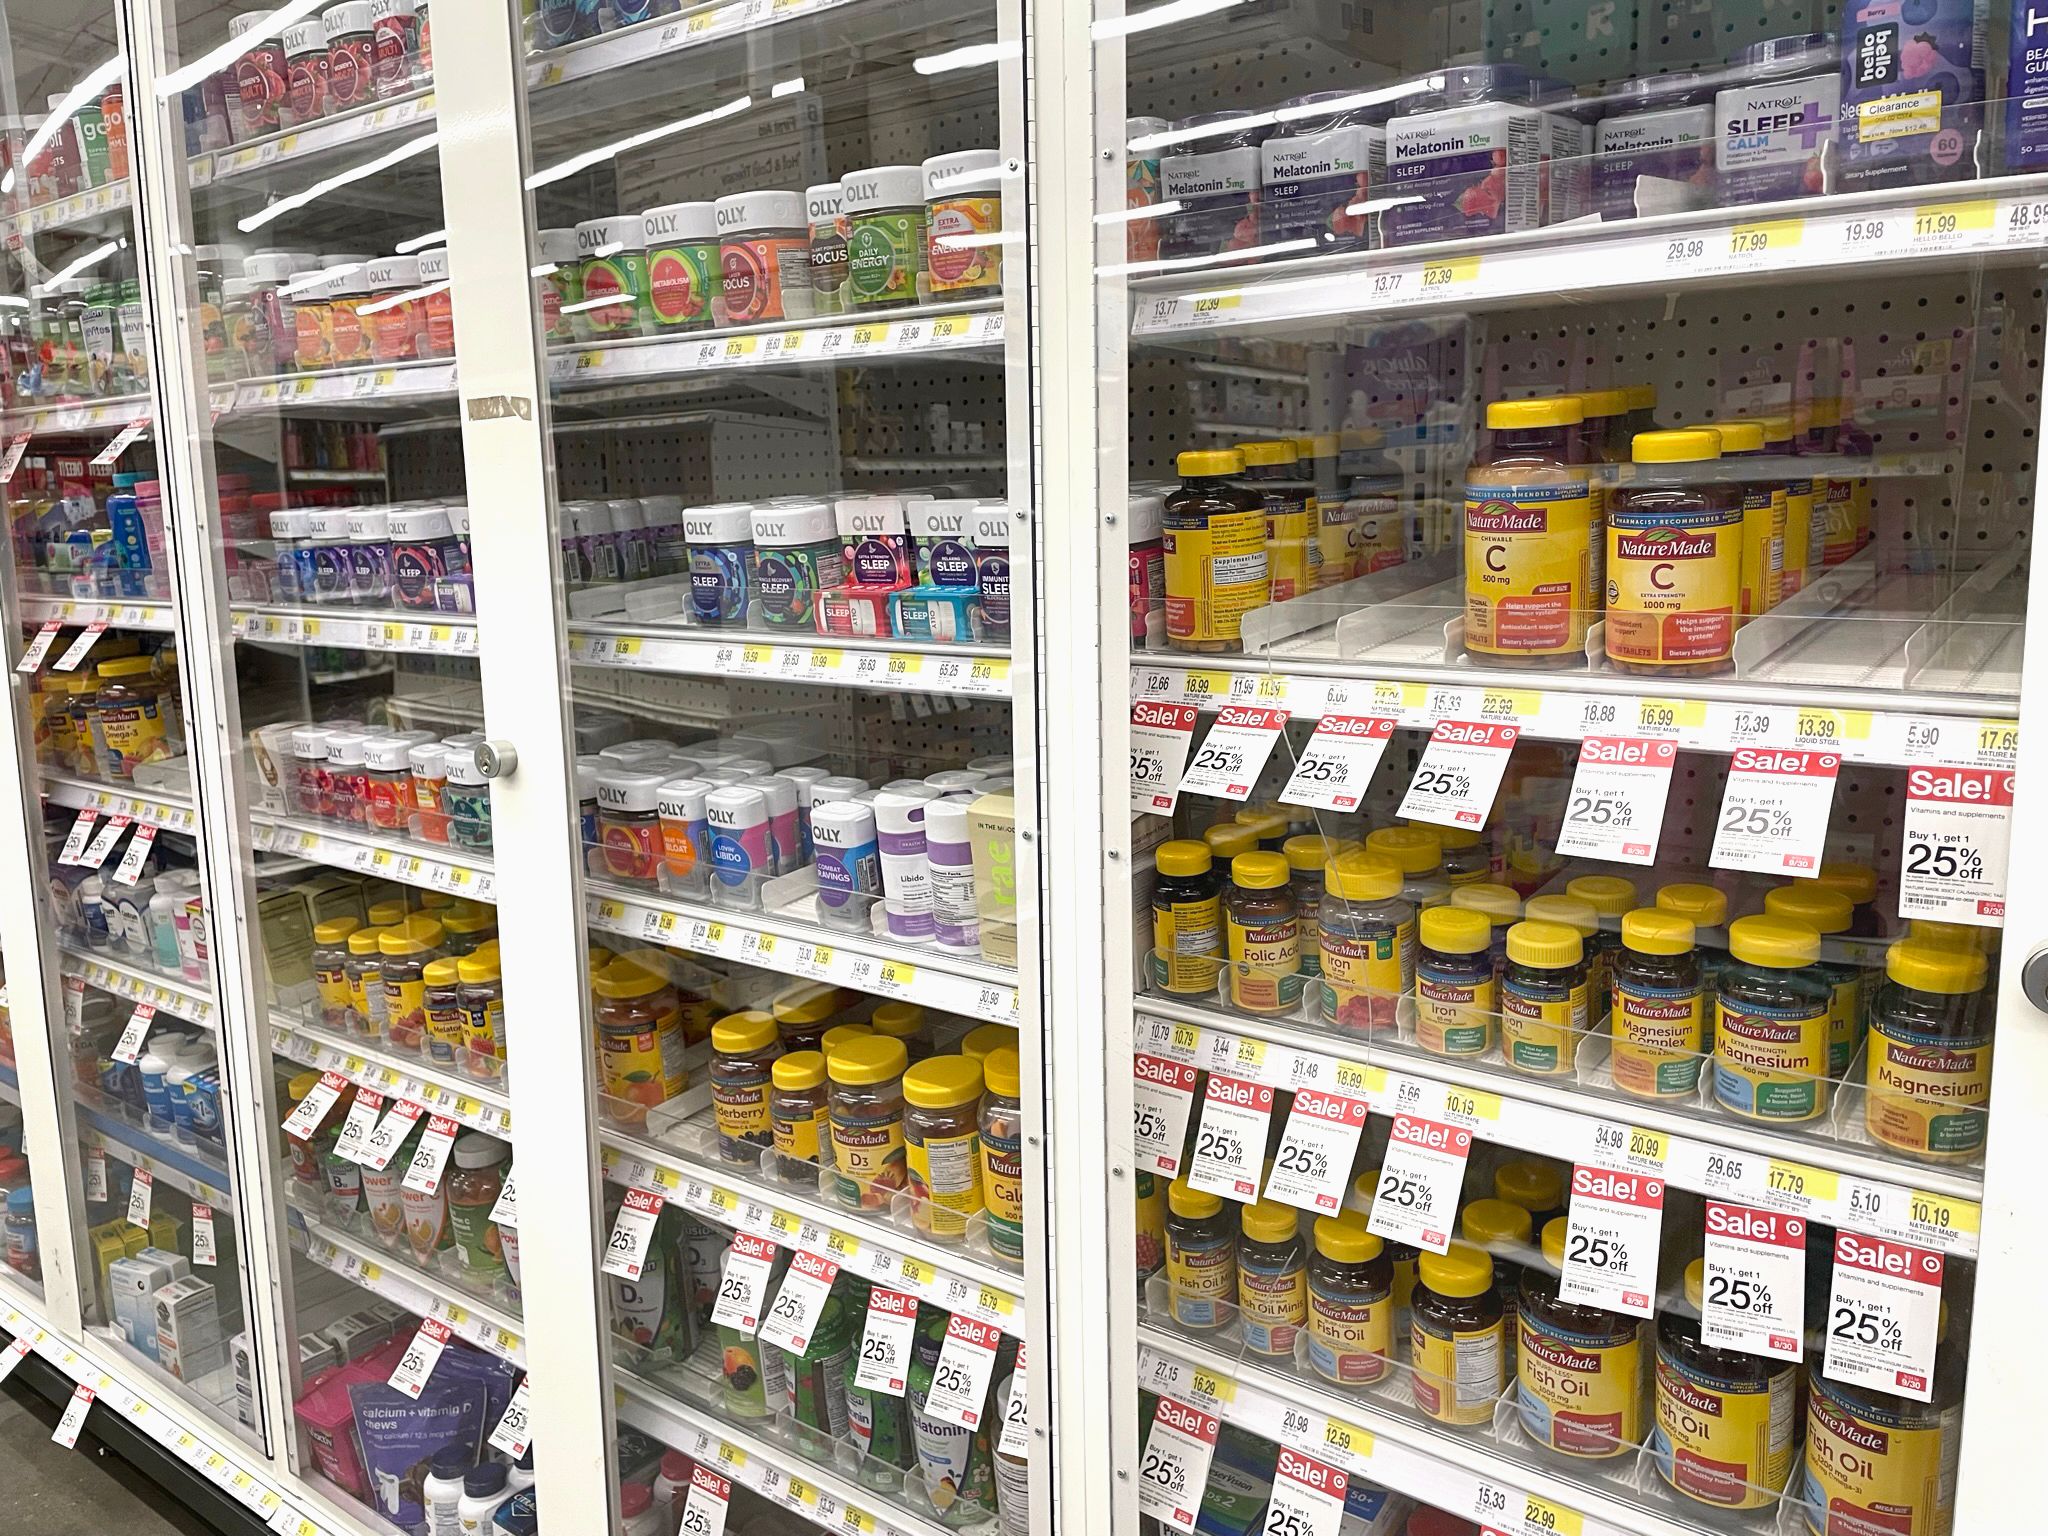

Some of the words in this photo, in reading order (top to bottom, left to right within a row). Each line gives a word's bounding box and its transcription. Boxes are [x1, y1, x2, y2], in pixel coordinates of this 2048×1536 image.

[1867, 9, 1886, 18] Berry
[1861, 33, 1875, 82] hello
[1875, 30, 1891, 79] bello
[1869, 99, 1919, 114] Clearance
[1396, 137, 1463, 157] Melatonin
[1468, 133, 1490, 147] 10mg
[1727, 135, 1769, 150] CALM
[1938, 139, 1957, 151] 60
[1273, 161, 1331, 178] Melatonin
[1334, 157, 1354, 172] 5mg
[1396, 164, 1425, 176] SLEEP
[1168, 178, 1222, 195] Melatonin
[1225, 176, 1245, 189] 5mg
[1274, 184, 1299, 196] SLEEP
[1845, 222, 1883, 240] 19.98
[1915, 216, 1956, 234] 11.99
[1939, 233, 1962, 241] BELLO
[859, 248, 878, 257] DAILY
[1667, 241, 1703, 260] 29.98
[1731, 235, 1767, 252] 17.99
[812, 250, 847, 265] FOCUS
[851, 255, 889, 269] ENERGY
[653, 278, 689, 287] METABOLISM
[723, 278, 749, 289] FOCUS
[1374, 275, 1401, 292] 13.77
[1423, 269, 1452, 286] 12.39
[853, 333, 871, 344] 16.39
[900, 329, 920, 339] 29.98
[933, 325, 952, 336] 17.99
[1493, 490, 1550, 498] RECOMMENDED
[852, 516, 885, 531] OLLY
[927, 516, 963, 531] OLLY
[1616, 517, 1657, 525] PHARMACIST
[1660, 515, 1719, 524] RECOMMENDED
[861, 560, 889, 570] SLEEP
[1486, 545, 1506, 572] C
[400, 569, 420, 577] SLEEP
[937, 562, 968, 572] SLEEP
[693, 577, 718, 587] SLEEP
[1483, 574, 1495, 583] 500
[1497, 576, 1510, 585] mg
[1650, 563, 1675, 590] C
[761, 584, 789, 593] SLEEP
[826, 608, 849, 617] SLEEP
[1643, 601, 1664, 609] 1000
[1666, 602, 1681, 610] mg
[903, 611, 927, 619] SLEEP
[1676, 617, 1697, 626] Helps
[1699, 614, 1724, 624] support
[1693, 623, 1721, 632] immune
[858, 659, 876, 671] 36.63
[888, 661, 905, 672] 10.99
[940, 664, 958, 676] 65.25
[971, 666, 990, 678] 23.49
[1147, 676, 1170, 690] 12.66
[1186, 679, 1209, 693] 18.99
[1234, 679, 1254, 694] 11.99
[1584, 704, 1616, 722] 18.88
[1640, 708, 1673, 726] 16.99
[1734, 714, 1770, 733] 13.39
[1798, 718, 1835, 738] 13.39
[1908, 726, 1939, 746] 5.90
[1909, 770, 1992, 800] Sale!
[1911, 807, 1940, 815] Vitamins
[1958, 811, 2005, 820] supplements
[1909, 832, 1928, 843] Buy
[1932, 833, 1939, 843] 1,
[1944, 834, 1961, 844] get
[1965, 835, 1969, 843] 1
[716, 851, 741, 862] LIBIDO
[818, 863, 840, 872] COMBAT
[1959, 868, 1982, 880] off
[1984, 906, 2004, 916] 9/30
[1244, 949, 1275, 961] Folic
[1328, 955, 1350, 970] Iron
[853, 962, 870, 975] 14.98
[880, 968, 894, 980] 8.99
[980, 991, 999, 1005] 30.98
[1432, 1003, 1457, 1017] Iron
[1151, 1023, 1169, 1041] 10.79
[1174, 1028, 1193, 1046] 10.79
[1623, 1018, 1692, 1036] Magnesium
[1214, 1038, 1229, 1055] 3.44
[1629, 1033, 1685, 1048] Complex
[1731, 1038, 1749, 1050] EXTRA
[1752, 1042, 1787, 1055] STRENGTH
[1717, 1037, 1809, 1069] Magnesium
[1292, 1060, 1318, 1078] 31.48
[1337, 1070, 1362, 1089] 18.89
[1879, 1066, 1983, 1097] Magnesium
[1399, 1083, 1420, 1101] 5.66
[1447, 1095, 1474, 1115] 10.19
[1596, 1127, 1623, 1149] 34.98
[1630, 1135, 1659, 1157] 20.99
[850, 1154, 868, 1167] D3
[1707, 1156, 1742, 1179] 29.65
[1769, 1172, 1804, 1193] 17.79
[624, 1191, 651, 1210] Sale!
[1851, 1190, 1880, 1212] 5.10
[1912, 1203, 1950, 1226] 10.19
[1707, 1207, 1777, 1240] Sale!
[1909, 1221, 1937, 1234] NATURE
[1939, 1229, 1959, 1238] MADE
[733, 1237, 764, 1256] Sale!
[1837, 1237, 1912, 1274] Sale!
[1180, 1277, 1199, 1289] Fish
[1202, 1276, 1218, 1289] Oil
[869, 1293, 905, 1312] Sale!
[1753, 1302, 1772, 1314] off
[948, 1317, 986, 1343] Sale!
[1317, 1320, 1340, 1338] Fish
[1344, 1328, 1365, 1341] Oil
[1774, 1341, 1793, 1350] 9/30
[1881, 1339, 1902, 1351] off
[885, 1354, 895, 1364] off
[1156, 1363, 1178, 1382] 27.15
[1194, 1376, 1216, 1396] 16.29
[1526, 1358, 1554, 1385] Fish
[1560, 1379, 1589, 1396] Oil
[1902, 1378, 1921, 1388] 9/30
[363, 1407, 406, 1418] calcium
[418, 1405, 460, 1416] vitamin
[464, 1403, 472, 1413] D
[365, 1420, 397, 1430] chews
[1284, 1411, 1308, 1433] 20.98
[1326, 1428, 1351, 1449] 12.59
[1809, 1422, 1836, 1455] Fish
[1839, 1455, 1873, 1481] Oil
[1478, 1486, 1506, 1510] 15.33
[1525, 1505, 1555, 1528] 22.99
